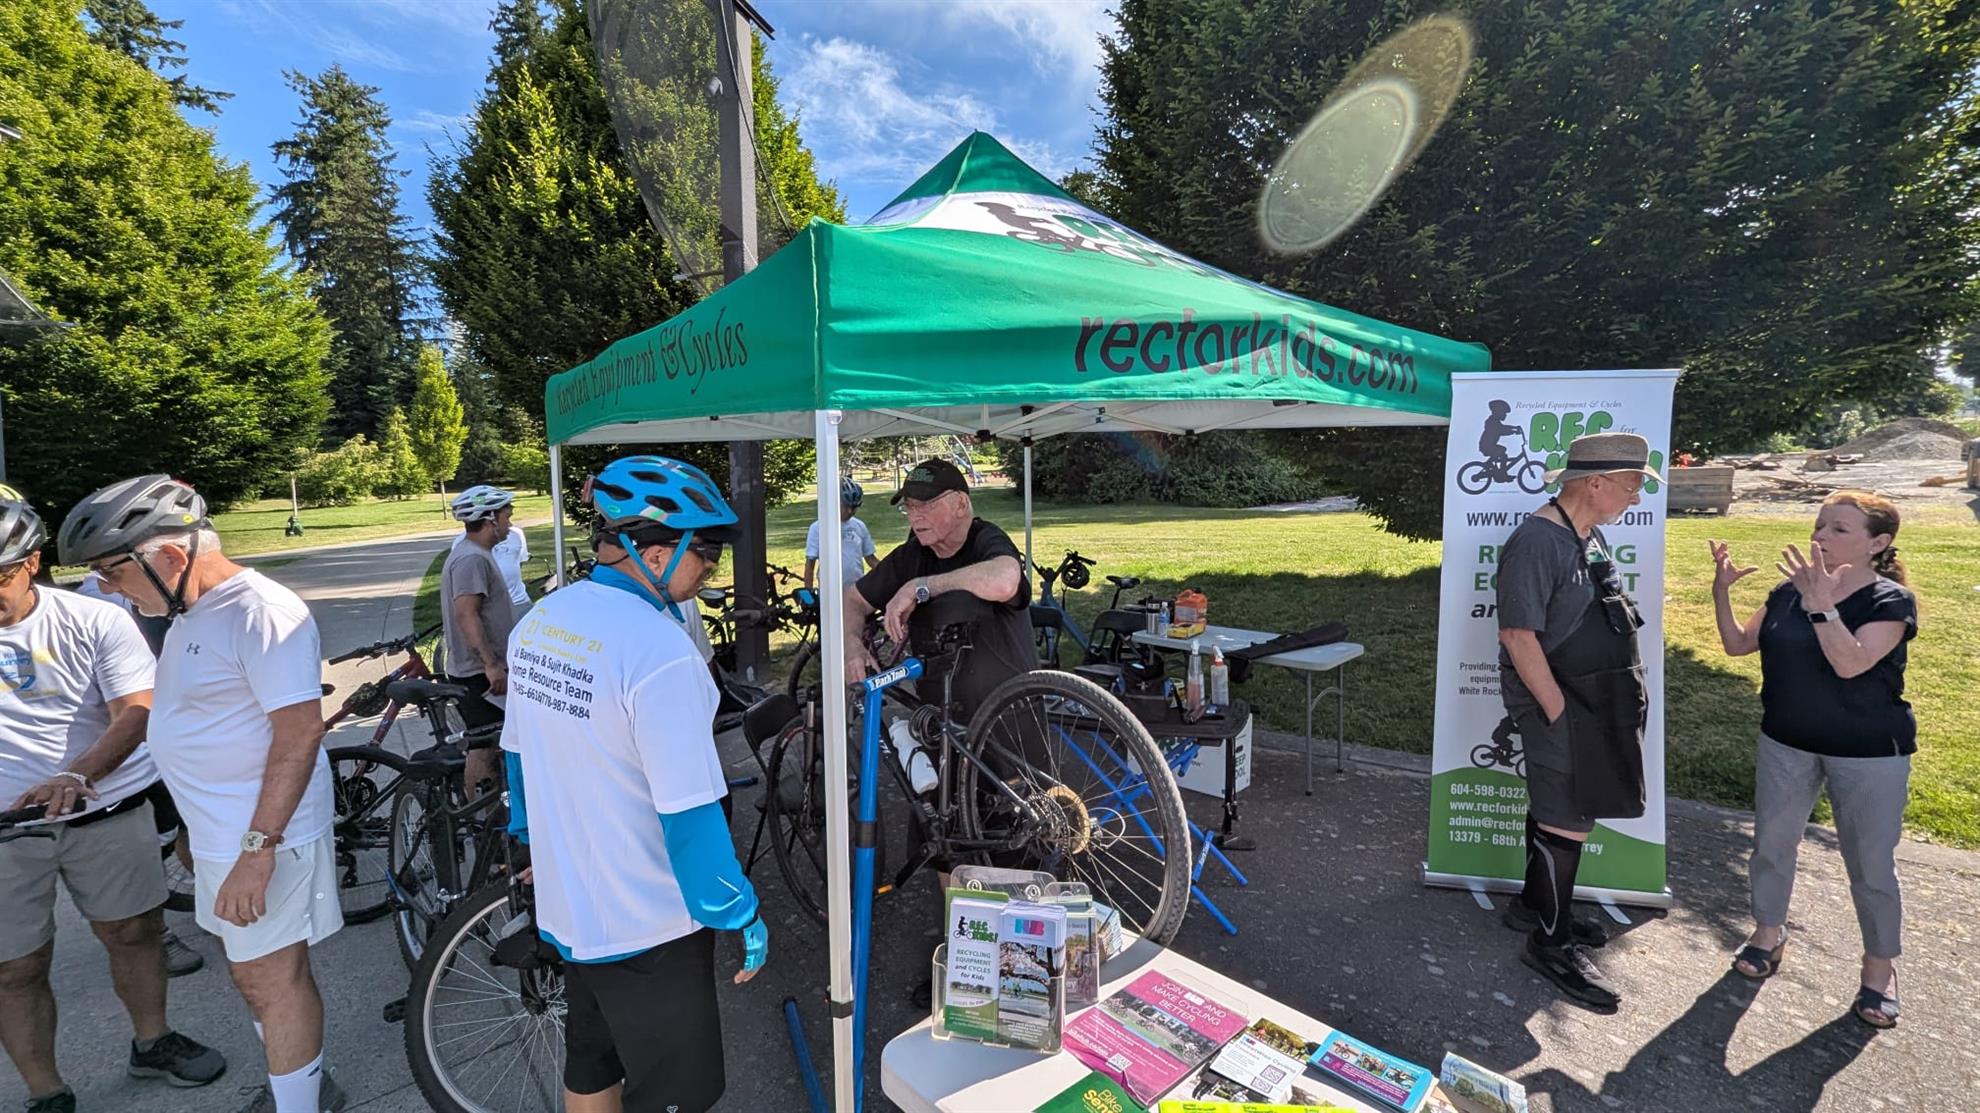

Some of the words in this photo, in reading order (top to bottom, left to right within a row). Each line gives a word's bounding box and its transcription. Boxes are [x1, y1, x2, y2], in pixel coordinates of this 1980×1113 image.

[591, 342, 658, 410] Equipment
[1515, 400, 1547, 409] Recycled
[1547, 401, 1587, 410] Equipment
[1600, 401, 1622, 409] Cycles
[541, 624, 586, 647] CENTURY
[519, 647, 540, 666] Baniya
[541, 654, 547, 667] &
[562, 662, 594, 684] Khadka
[1459, 662, 1497, 673] Providing
[528, 666, 562, 693] Resource
[564, 680, 593, 704] Team
[1470, 675, 1501, 685] equipm
[1459, 686, 1481, 696] White
[1450, 783, 1526, 799] 604-598-0322
[1449, 801, 1527, 815] www.recforkid
[1449, 815, 1526, 831] admin@recfor
[1449, 831, 1481, 844] 13379
[1492, 834, 1517, 846] 68th
[1014, 918, 1045, 936] HUB
[955, 956, 991, 966] EQUIPMENT
[956, 949, 991, 959] RECYCLING
[960, 971, 970, 979] for
[971, 972, 985, 981] Kids
[968, 965, 991, 974] CYCLES
[1151, 985, 1180, 1001] MAKE
[1178, 999, 1221, 1026] CYCLING
[1161, 982, 1185, 995] JOIN
[1203, 1004, 1227, 1018] AND
[1158, 998, 1196, 1023] BETTER
[1097, 1089, 1123, 1113] Bike
